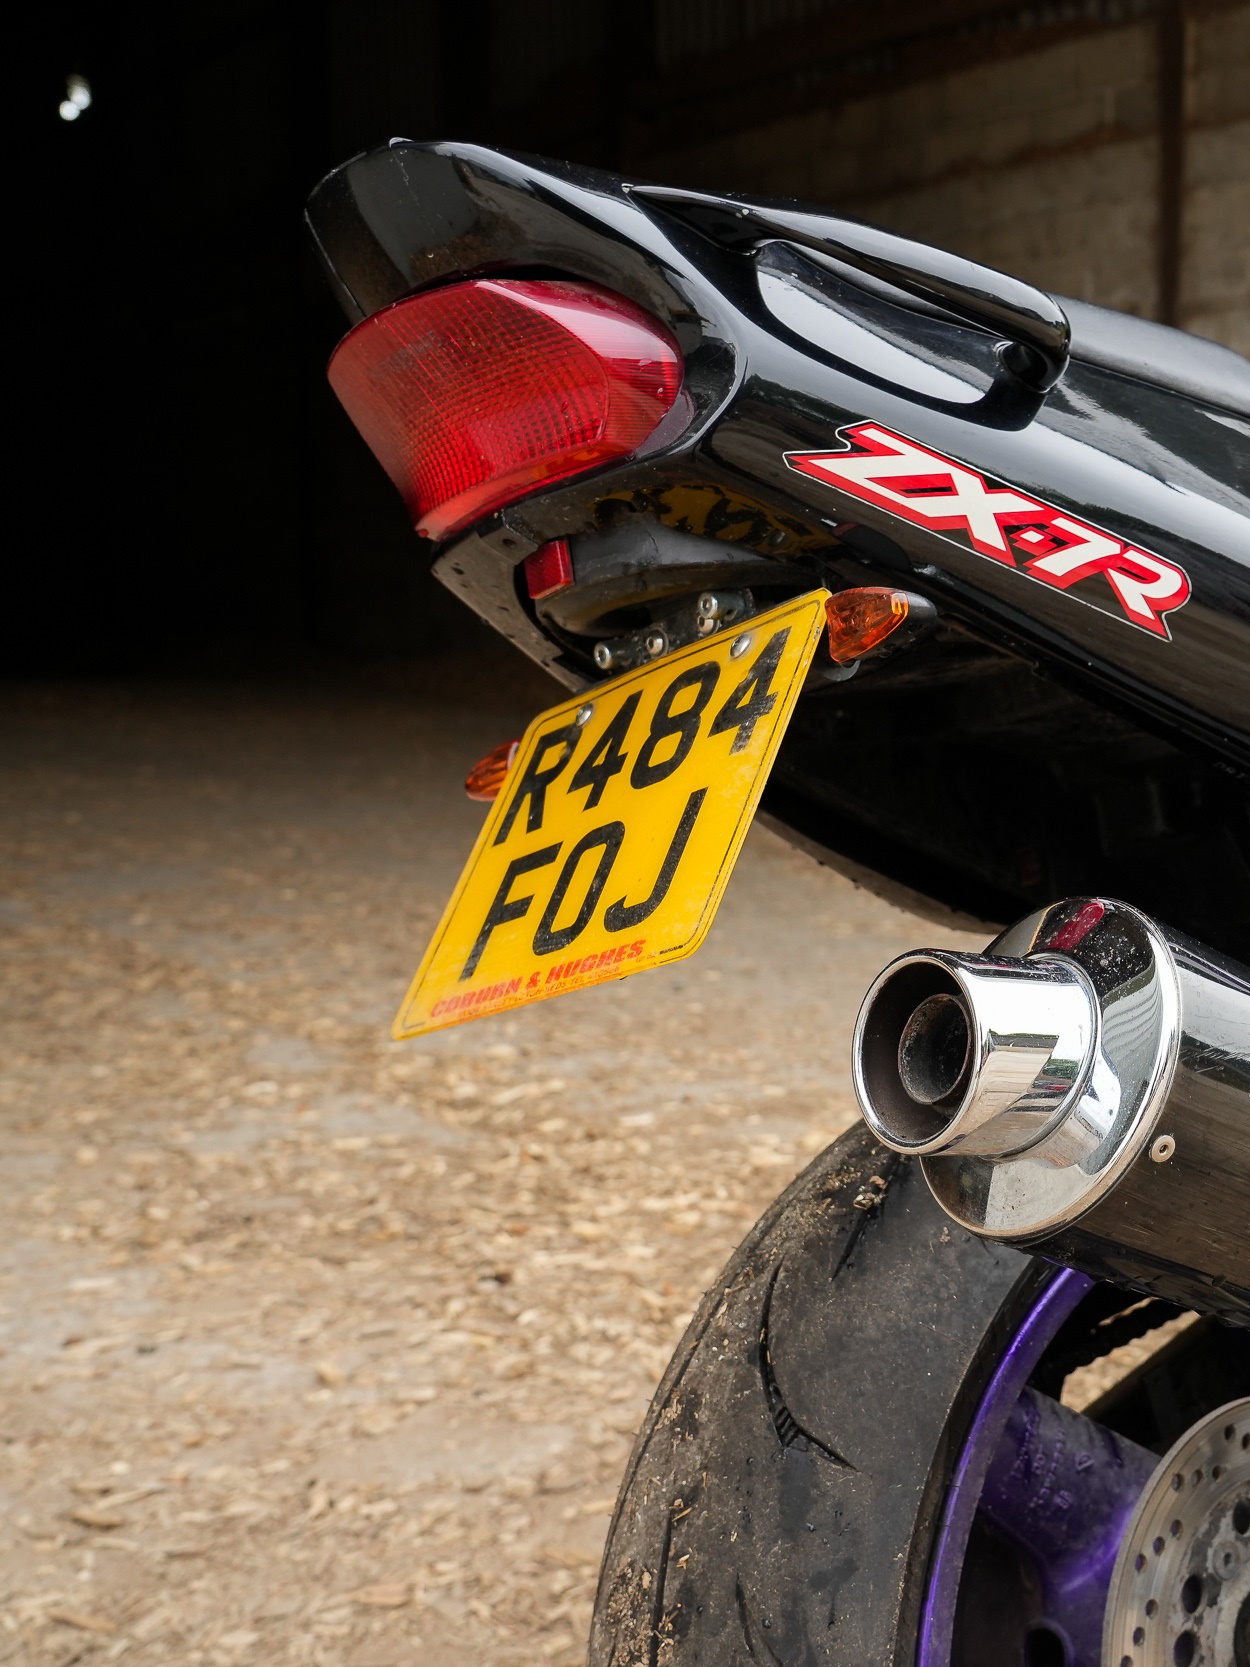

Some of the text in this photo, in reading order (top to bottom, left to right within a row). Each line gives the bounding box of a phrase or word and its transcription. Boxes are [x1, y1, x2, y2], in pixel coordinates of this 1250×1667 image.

[493, 626, 792, 847] R484
[430, 976, 523, 1017] COBURN
[525, 971, 541, 990] &
[545, 939, 646, 984] HUGHES
[458, 787, 708, 982] FOJ
